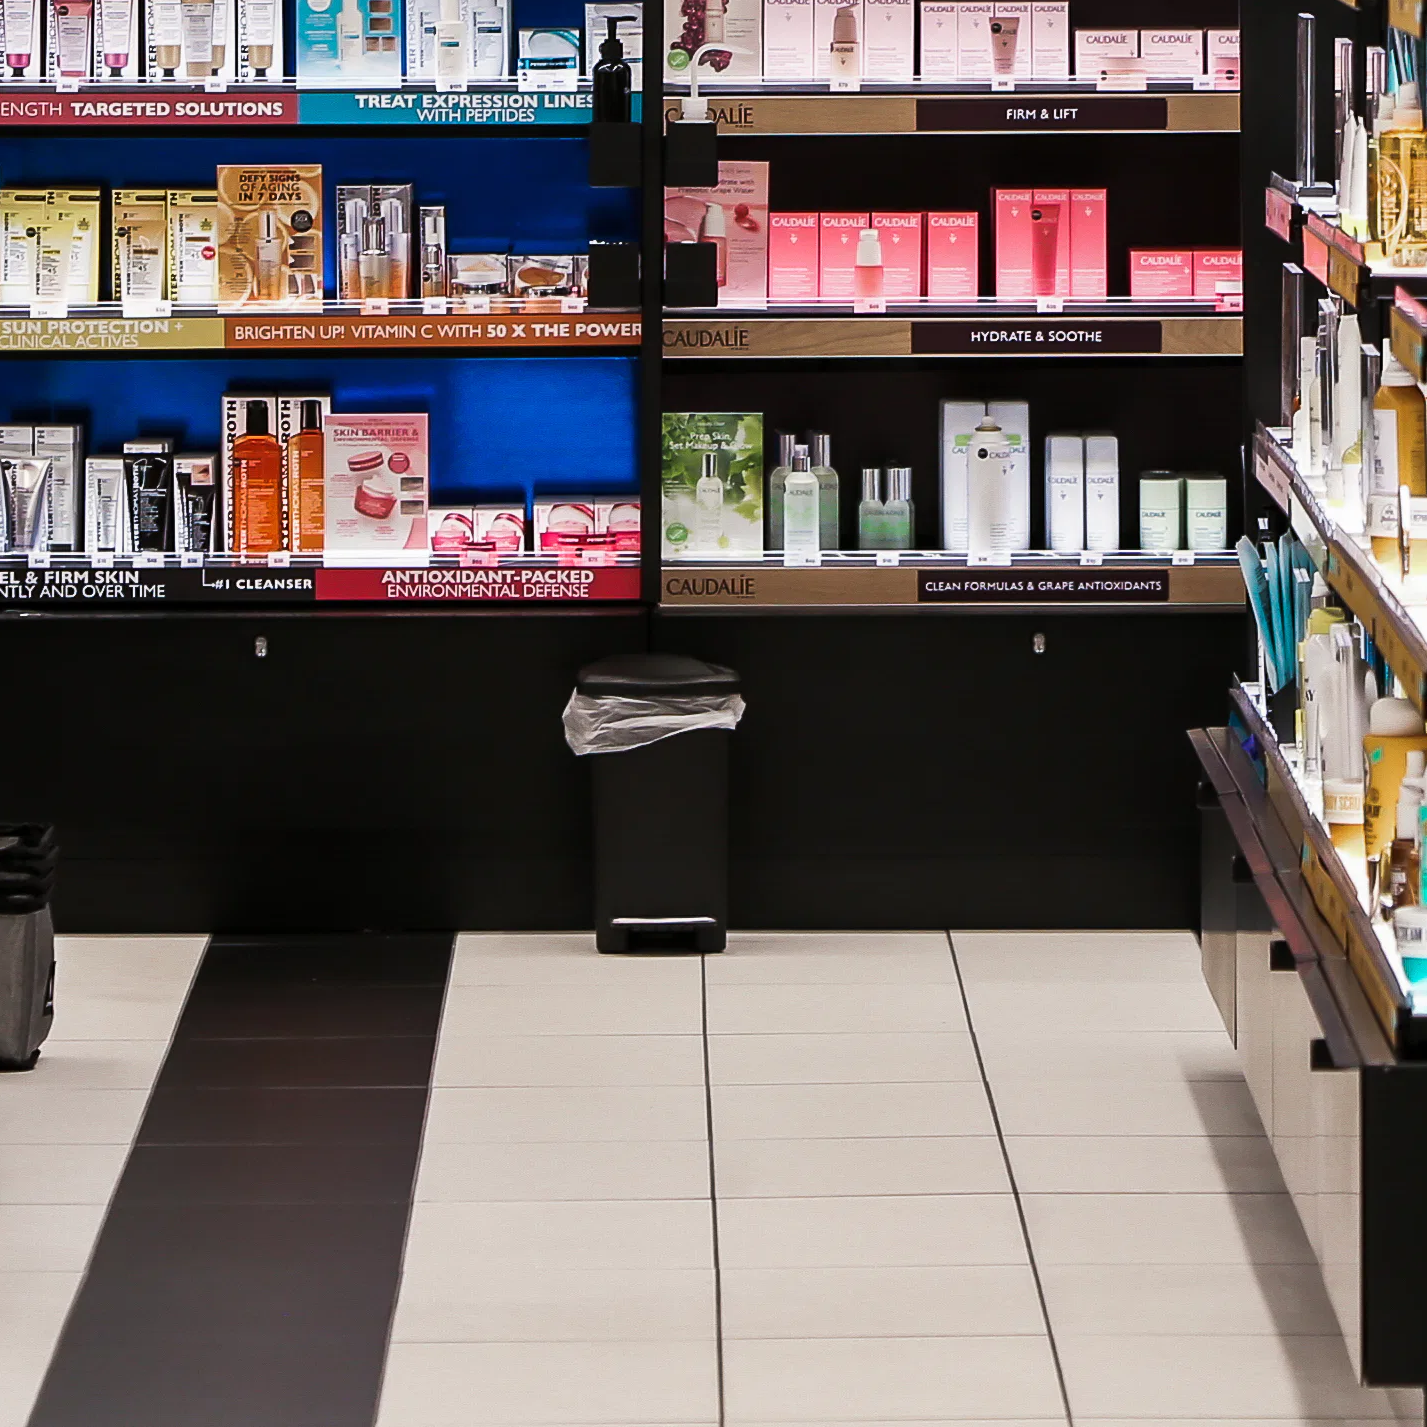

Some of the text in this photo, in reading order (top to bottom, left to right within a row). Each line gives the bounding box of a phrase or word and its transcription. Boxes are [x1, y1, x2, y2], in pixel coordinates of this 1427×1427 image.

[355, 95, 418, 108] TREAT
[422, 95, 538, 108] EXPRESSION
[71, 102, 170, 116] TARGETED
[175, 102, 283, 116] SOLUTIONS
[417, 109, 534, 122] WITH PEPTIDES
[1006, 108, 1077, 120] FIRM & LIFT
[2, 322, 37, 334] SUN
[43, 321, 169, 334] PROTECTION
[235, 323, 642, 341] BRIGHTEN UP! VITAMIN C WITH 50 X THE POWER
[75, 335, 138, 348] ACTIVES
[971, 330, 1102, 342] HYDRATE & SOOTHE
[25, 572, 38, 584] &
[44, 572, 90, 584] FIRM
[95, 571, 138, 584] SKIN
[382, 570, 593, 584] ANTIOXIDANT-PACKED
[215, 578, 312, 591] #1 CLEANSER
[926, 581, 1162, 591] CLEAN FORMULAS & GRAPE ANTIOXIDANTS
[40, 585, 77, 598] AND
[82, 586, 125, 599] OVER
[130, 586, 165, 598] TIME
[388, 584, 588, 599] ENVIRONMENTAL DEFENSE
